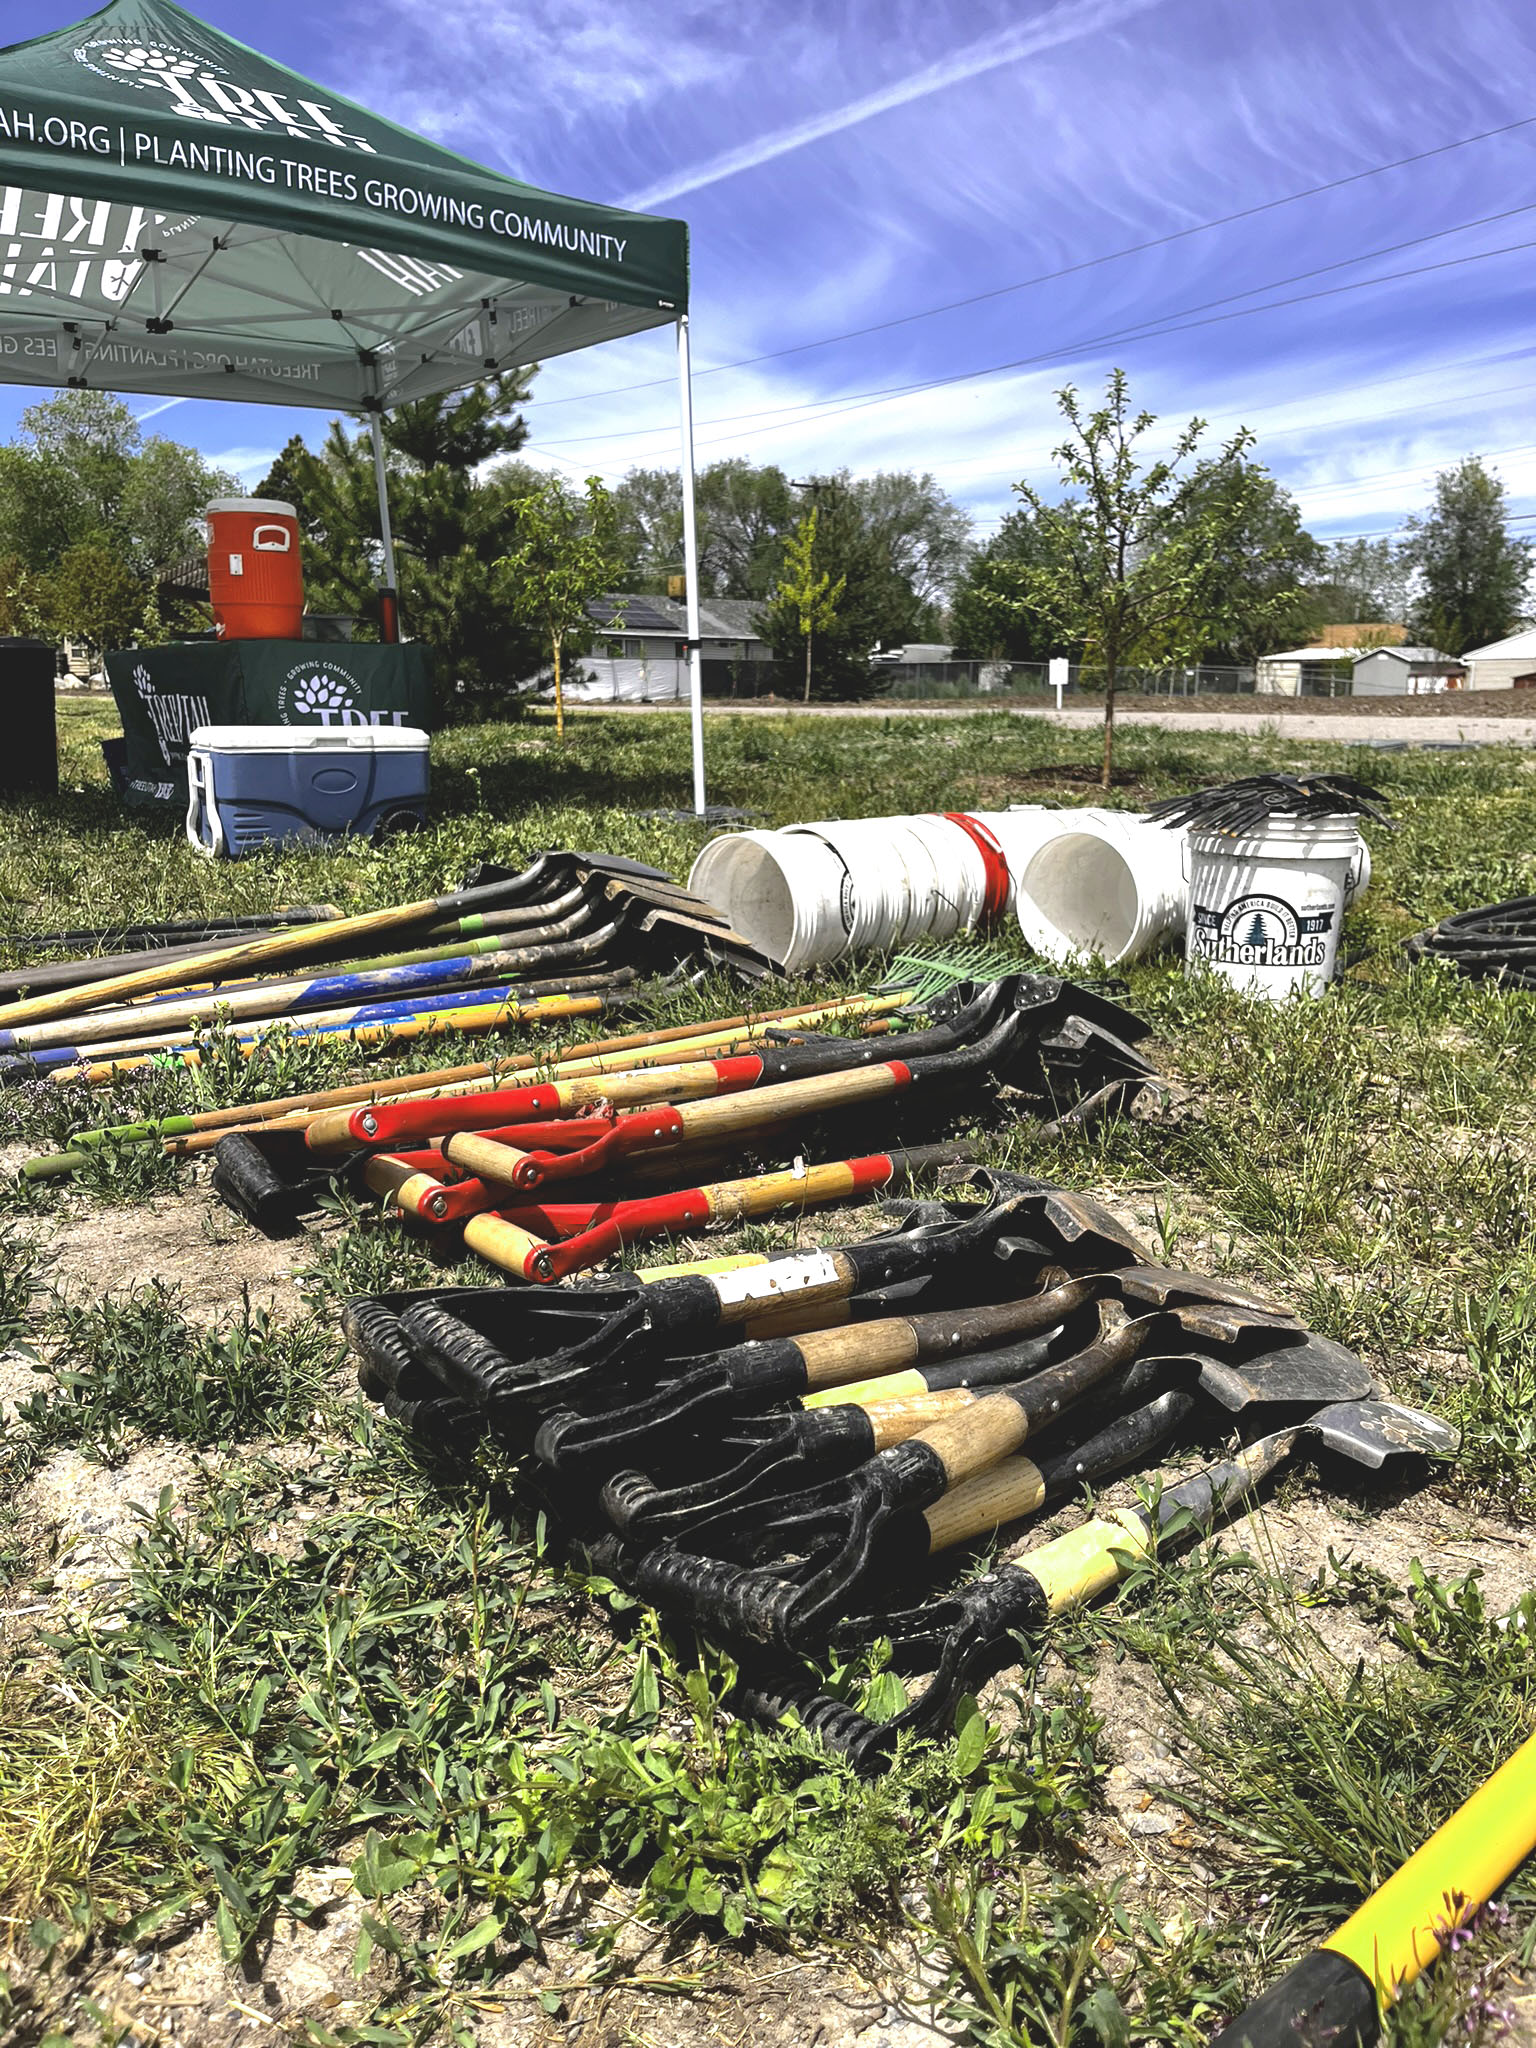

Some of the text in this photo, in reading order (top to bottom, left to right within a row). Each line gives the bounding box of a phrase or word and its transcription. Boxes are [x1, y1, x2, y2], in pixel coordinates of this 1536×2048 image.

[149, 41, 231, 75] COMMUNITY
[140, 67, 367, 142] TREE
[135, 132, 276, 184] PLANTING
[280, 159, 358, 201] TREES
[364, 180, 484, 229] GROWING
[489, 209, 627, 262] COMMUNITY
[286, 660, 320, 680] GROWING
[322, 661, 363, 695] COMMUNITY
[1197, 912, 1216, 927] SINCE
[1223, 909, 1240, 932] HELPING
[1237, 900, 1265, 914] AMERICA
[1265, 901, 1284, 915] BUILD
[1306, 918, 1324, 932] 1917
[1194, 927, 1326, 967] Sutherlands
